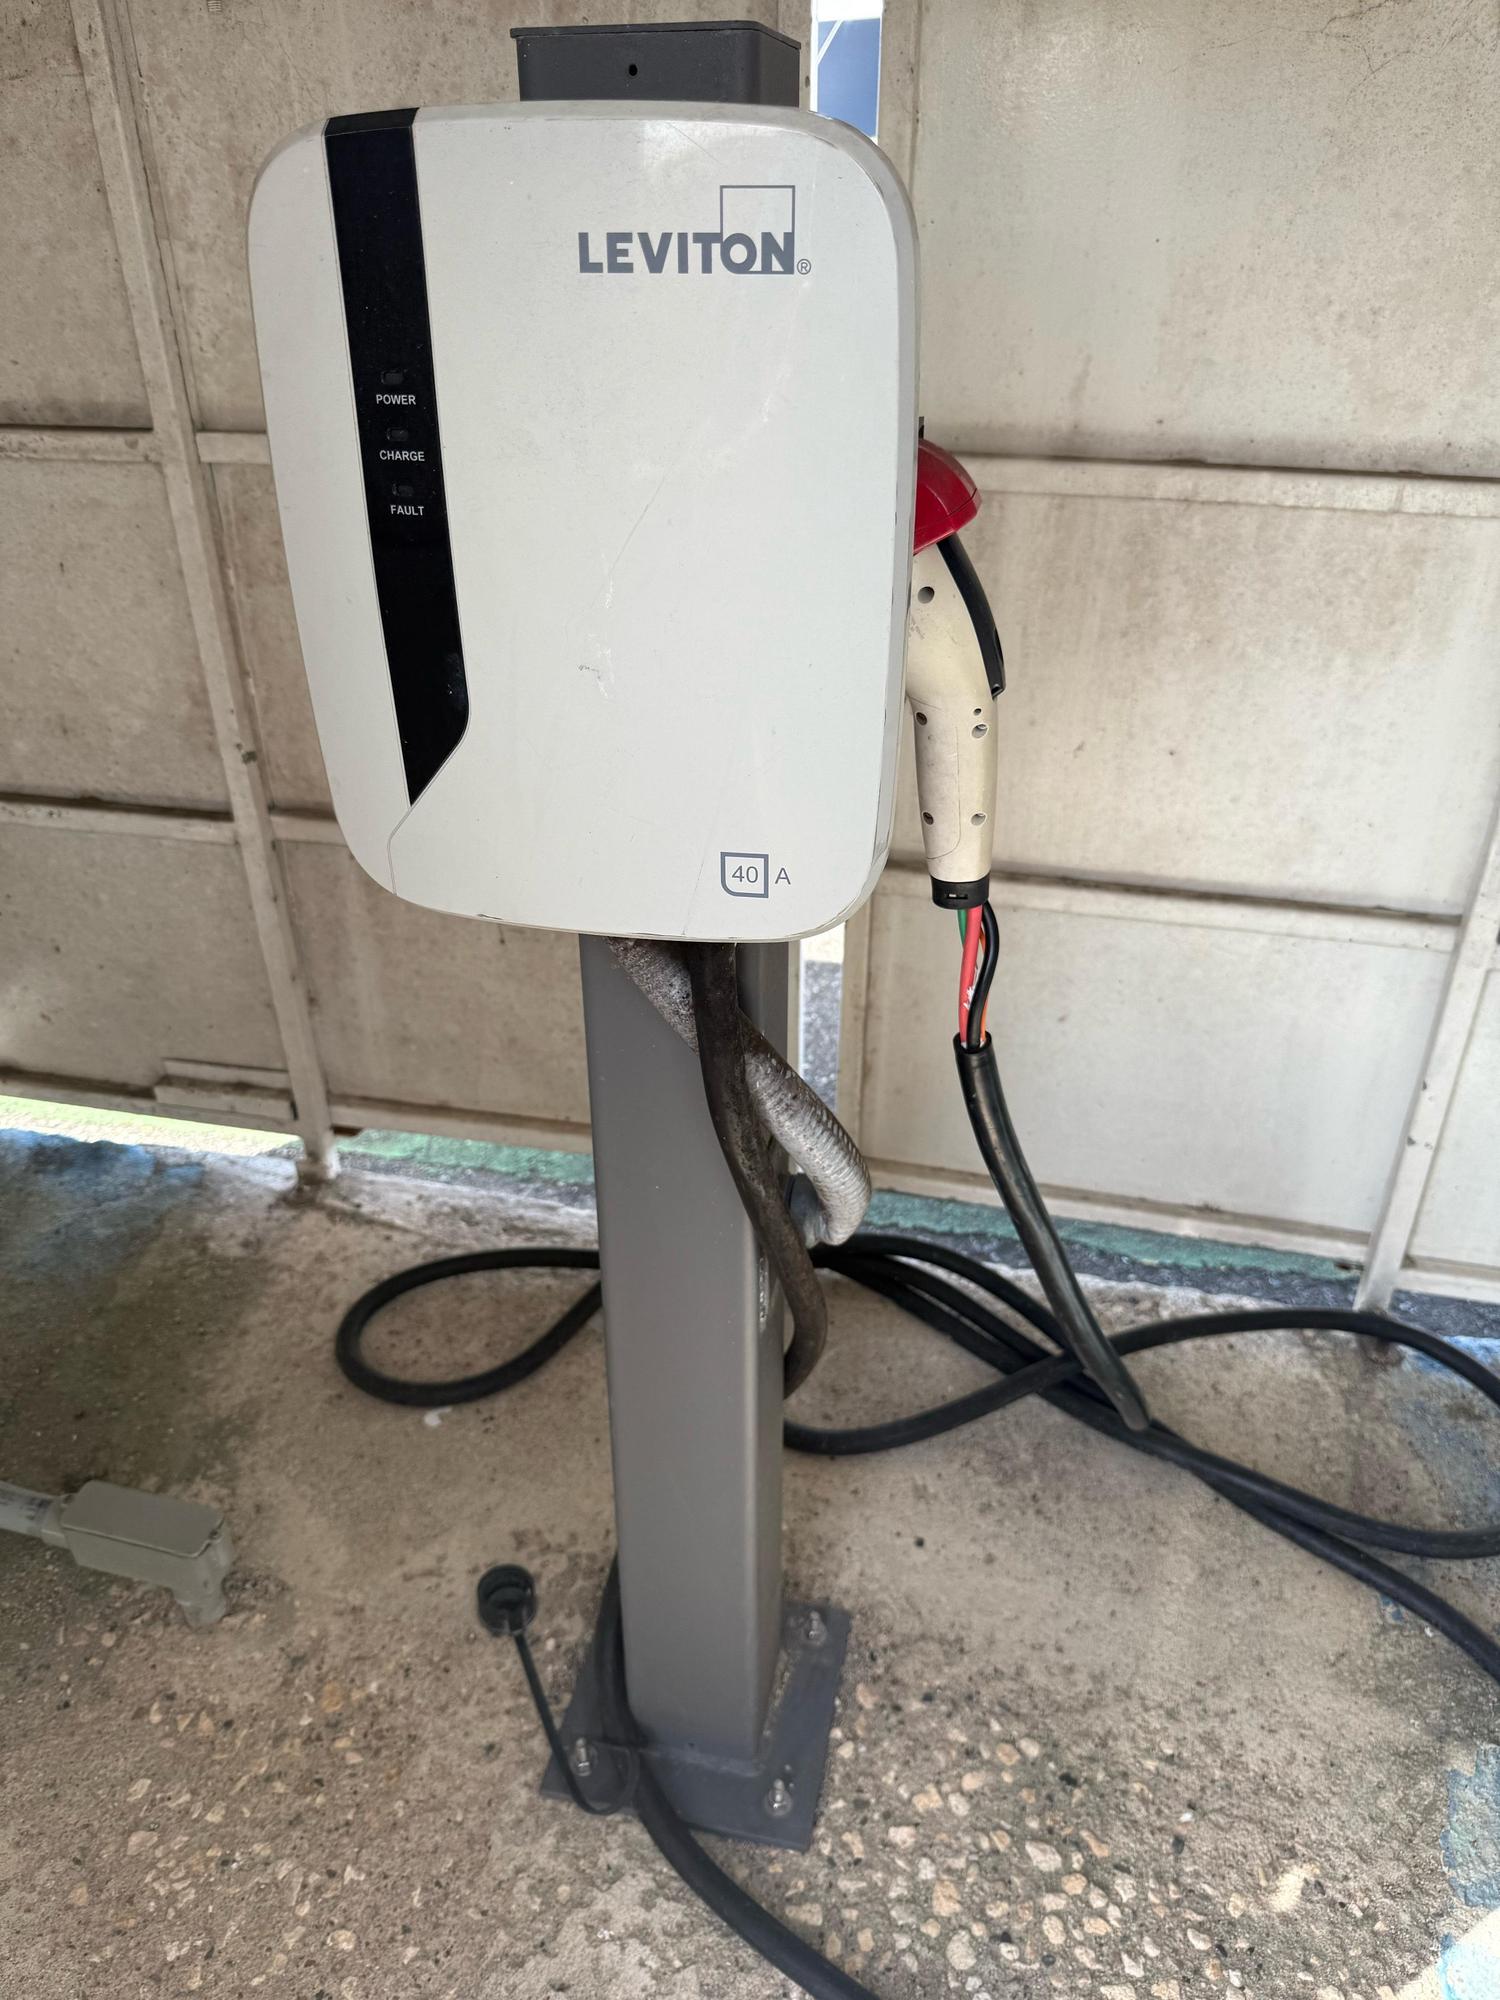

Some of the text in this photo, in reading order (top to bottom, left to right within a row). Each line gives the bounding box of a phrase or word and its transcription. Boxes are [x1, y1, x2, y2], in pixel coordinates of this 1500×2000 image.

[376, 394, 416, 405] POWER
[379, 450, 425, 462] CHARGE
[390, 504, 424, 516] FAULT
[731, 865, 791, 885] 40 A
